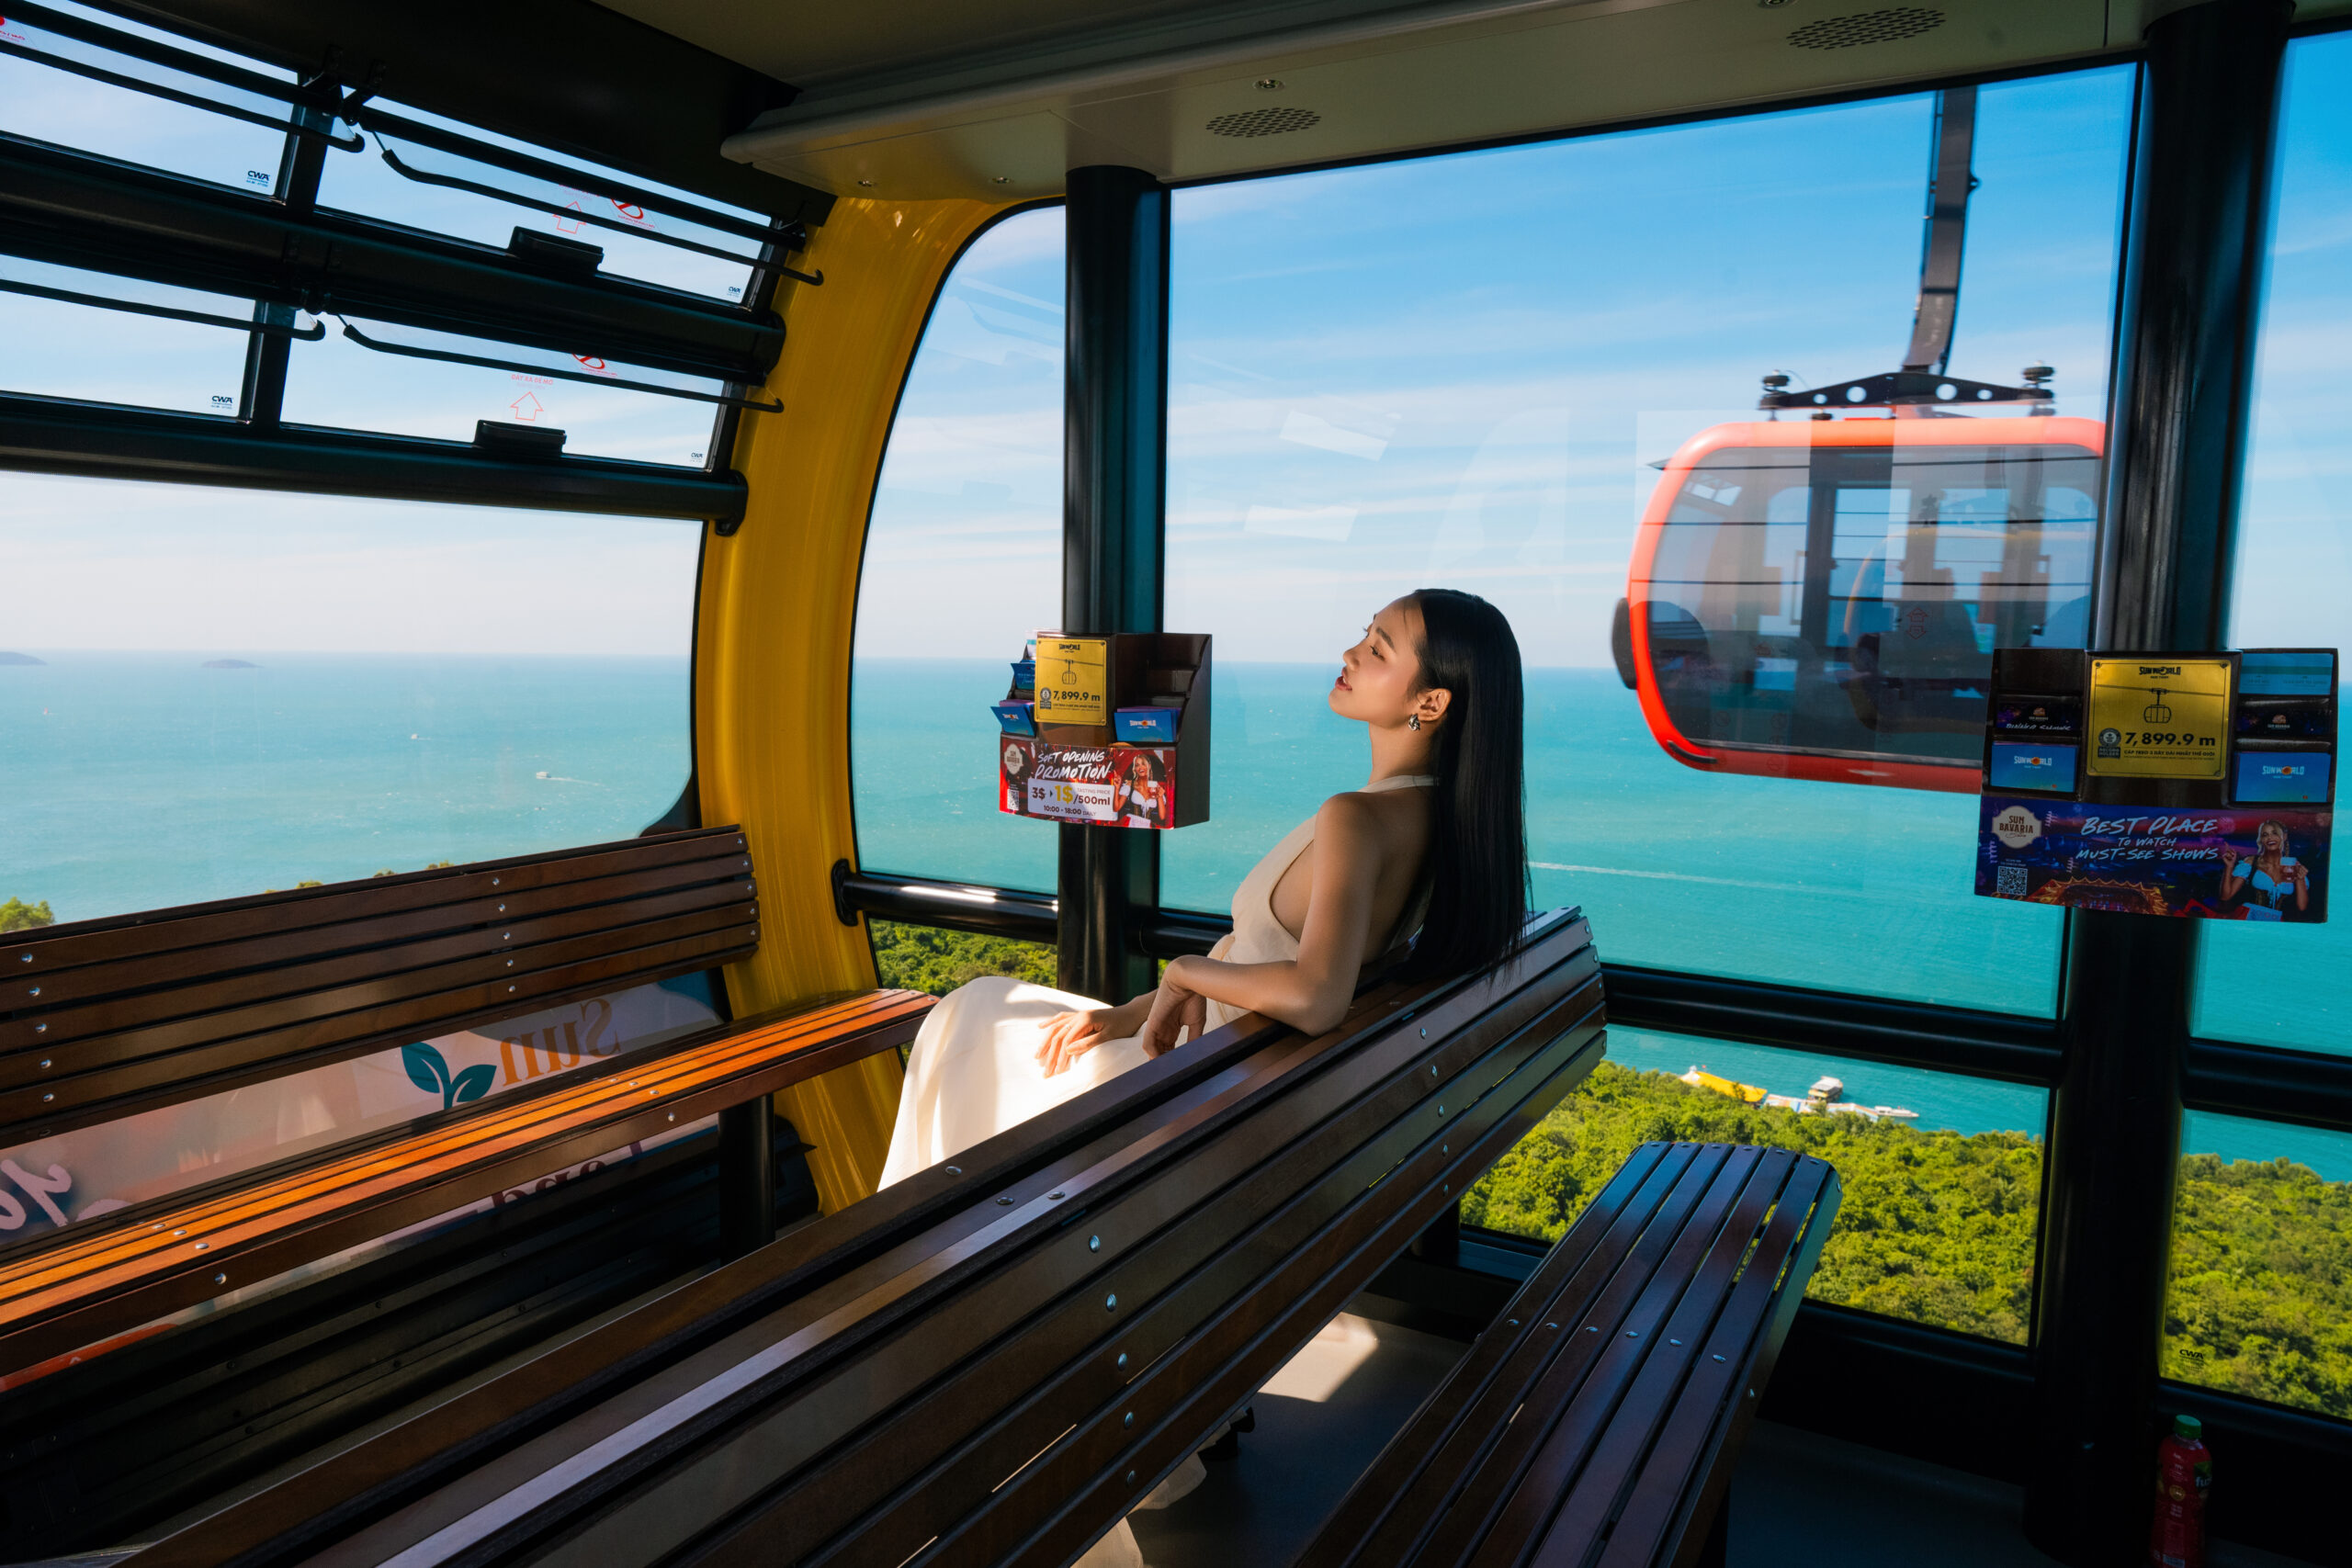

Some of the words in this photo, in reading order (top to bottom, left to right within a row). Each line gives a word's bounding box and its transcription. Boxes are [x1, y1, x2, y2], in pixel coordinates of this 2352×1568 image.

[247, 170, 269, 181] CWA
[211, 395, 233, 403] CWA
[2199, 738, 2216, 746] m
[1038, 750, 1062, 763] SOFT
[1062, 750, 1105, 763] OPENING
[1035, 761, 1113, 780] PROMOTION
[1032, 787, 1046, 800] 3$
[2008, 815, 2025, 824] SUN
[1999, 823, 2033, 833] BAVARIA
[2081, 817, 2148, 836] BEST
[2147, 816, 2219, 835] PLACE
[2135, 837, 2177, 847] WATCH
[2075, 847, 2155, 861] MUST-SEE
[2160, 847, 2219, 861] SHOWS
